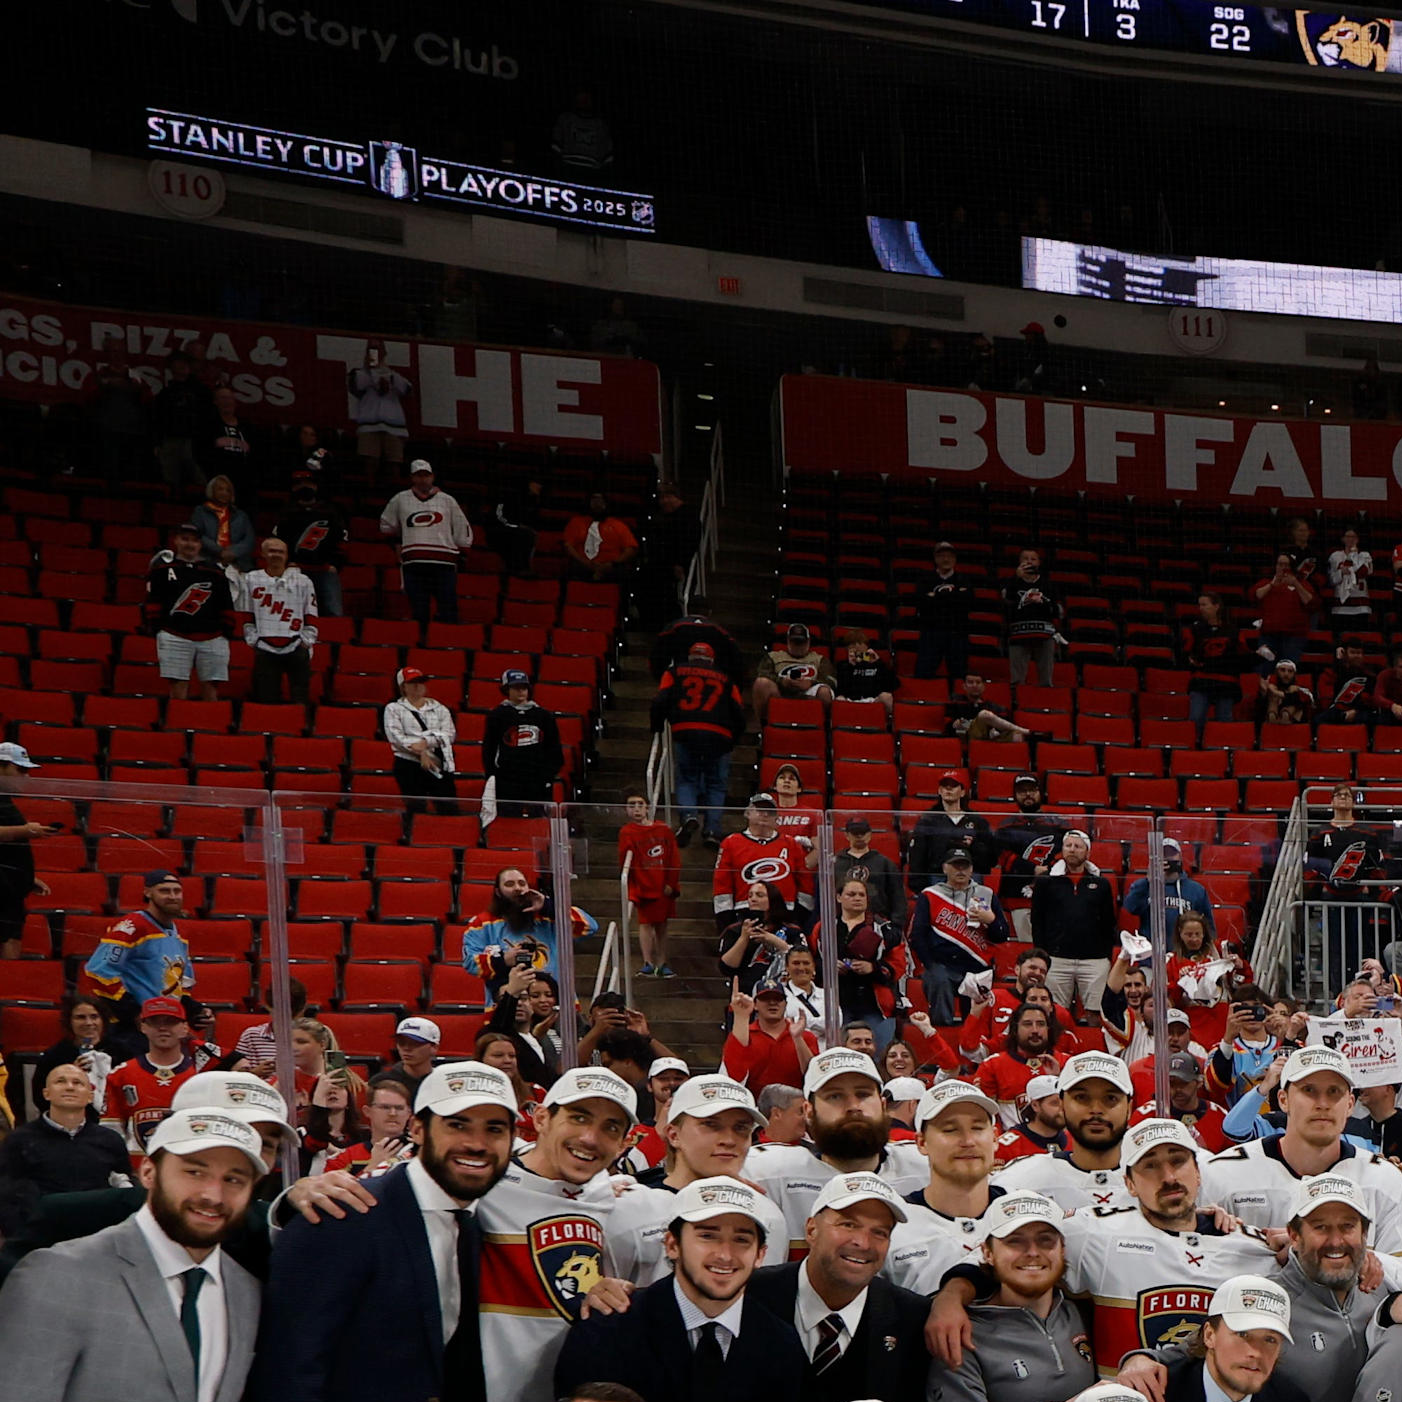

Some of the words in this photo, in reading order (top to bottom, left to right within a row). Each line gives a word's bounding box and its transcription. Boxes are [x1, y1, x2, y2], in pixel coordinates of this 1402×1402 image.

[1030, 0, 1066, 30] 17
[1214, 6, 1245, 20] SOG
[1116, 13, 1137, 40] 3
[1209, 22, 1251, 51] 22
[413, 31, 520, 81] Club
[147, 116, 293, 163] STANLEY
[303, 145, 364, 173] CUP
[422, 164, 577, 213] PLAYOFFS
[583, 198, 626, 217] 2025
[162, 170, 211, 201] 110
[1181, 315, 1214, 338] 111
[249, 335, 289, 368] &
[316, 333, 604, 440] THE
[252, 587, 301, 632] CANES
[679, 675, 724, 712] 37
[776, 815, 810, 826] ANES
[1313, 1052, 1343, 1067] CHAMPS
[1341, 1043, 1378, 1059] Siren
[832, 1058, 866, 1073] CHAMPS
[1087, 1059, 1119, 1076] CHAMPS
[1145, 1126, 1180, 1142] CHAMPS
[717, 1189, 756, 1207] CHAMPS
[1321, 1183, 1353, 1199] CHAMPS
[1019, 1202, 1051, 1217] CHAMPS
[1119, 1242, 1154, 1252] AutoNation
[1149, 1290, 1210, 1312] FLORI
